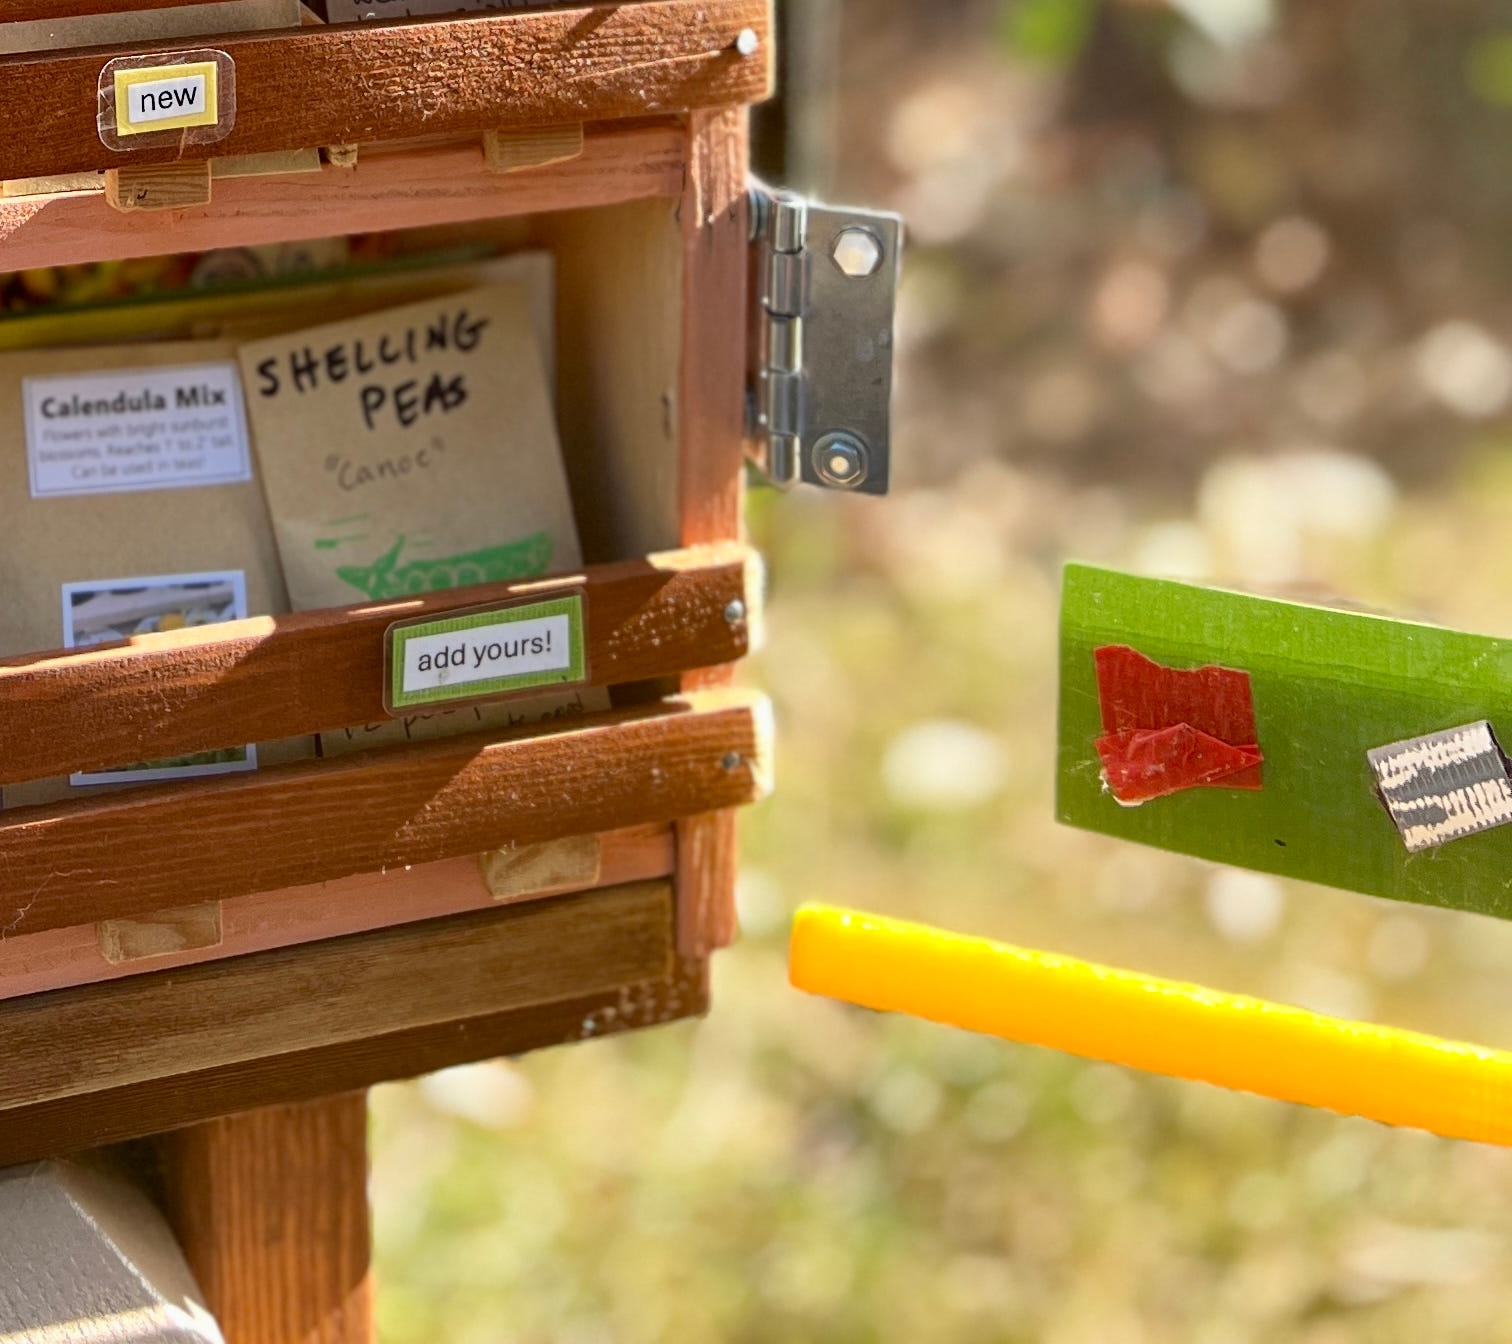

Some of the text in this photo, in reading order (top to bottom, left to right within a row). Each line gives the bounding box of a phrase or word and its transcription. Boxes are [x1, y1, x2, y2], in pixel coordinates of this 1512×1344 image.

[140, 85, 199, 113] new
[257, 307, 489, 398] SHELLING
[39, 385, 226, 419] Calendula Mix
[360, 372, 468, 429] PEAS
[416, 629, 553, 672] add yours!
